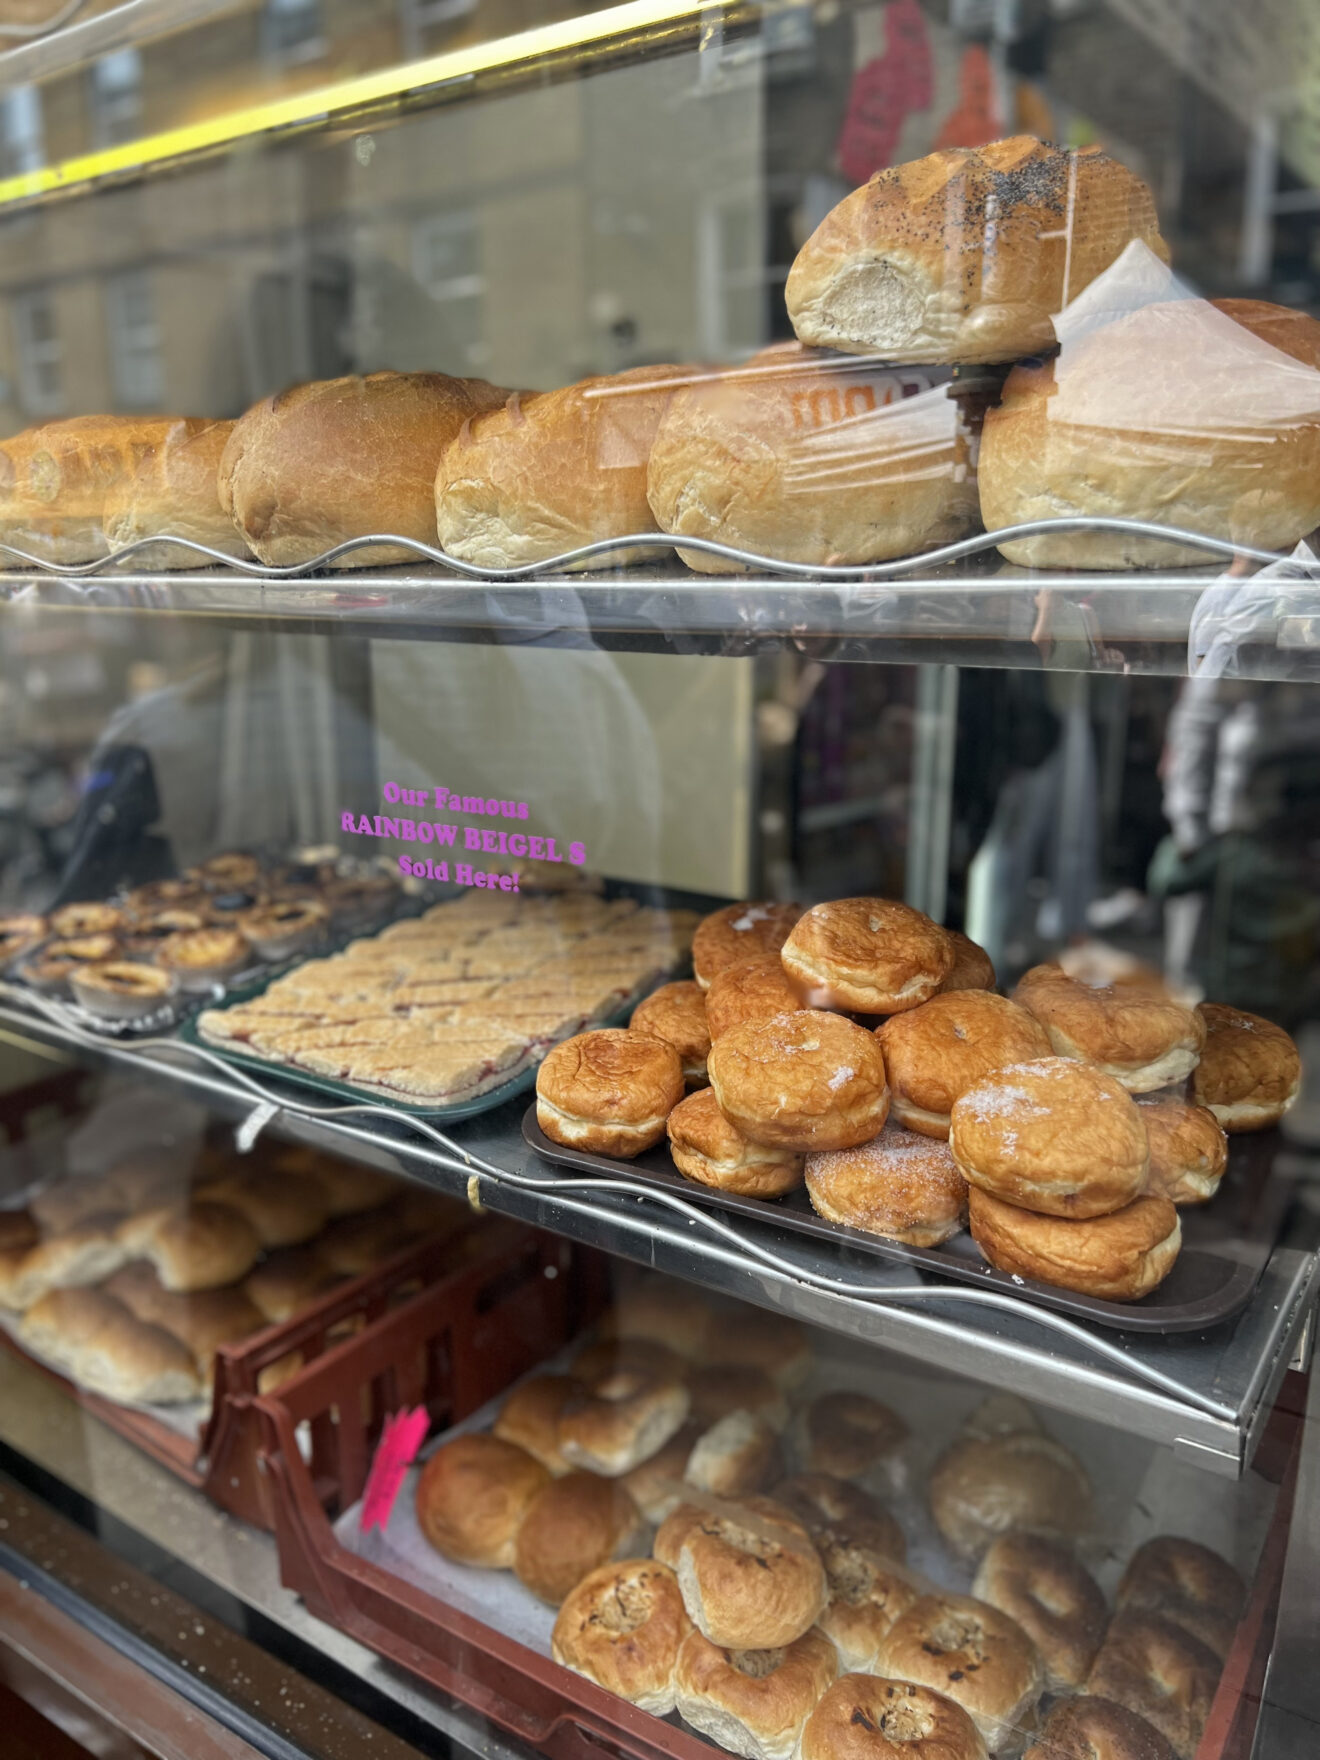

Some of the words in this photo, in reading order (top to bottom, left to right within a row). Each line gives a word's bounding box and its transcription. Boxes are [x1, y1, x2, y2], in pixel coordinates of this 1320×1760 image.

[383, 782, 429, 807] Our
[434, 787, 530, 820] Famous
[340, 811, 459, 848] RAINBOW
[397, 855, 450, 882] Sold
[456, 864, 521, 894] Here!
